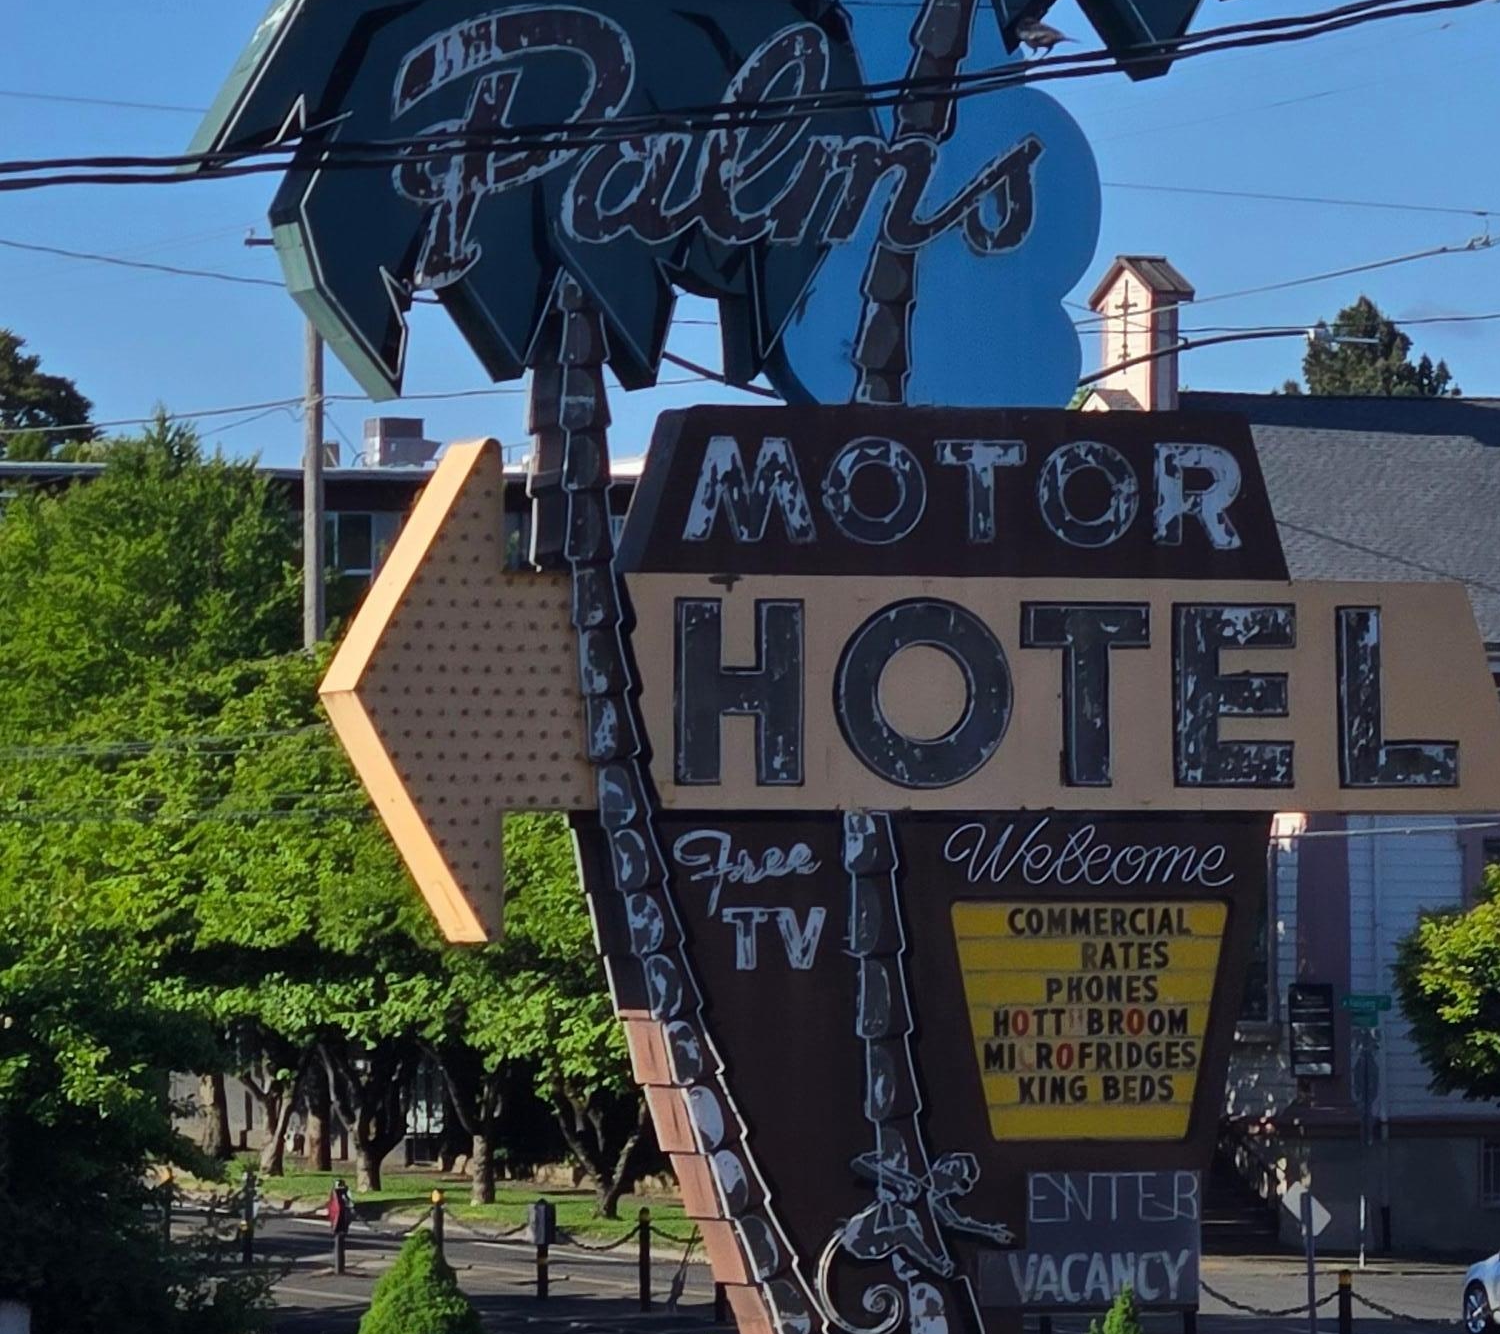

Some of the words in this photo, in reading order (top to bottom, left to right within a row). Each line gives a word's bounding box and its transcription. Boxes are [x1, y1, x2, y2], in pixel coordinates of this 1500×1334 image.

[391, 4, 1044, 290] Palms
[682, 435, 1243, 550] MOTOR
[673, 597, 1461, 789] HOTEL
[672, 829, 822, 917] Free
[944, 817, 1235, 887] Welcome
[721, 906, 827, 971] TV
[1007, 907, 1192, 936] COMMERCIAL
[1081, 941, 1170, 970] RATES
[1046, 975, 1159, 1003] PHONES
[1018, 1075, 1088, 1104] KING
[1102, 1074, 1175, 1103] BEDS
[1028, 1171, 1198, 1223] ENTER
[1007, 1248, 1194, 1304] VACANCY
